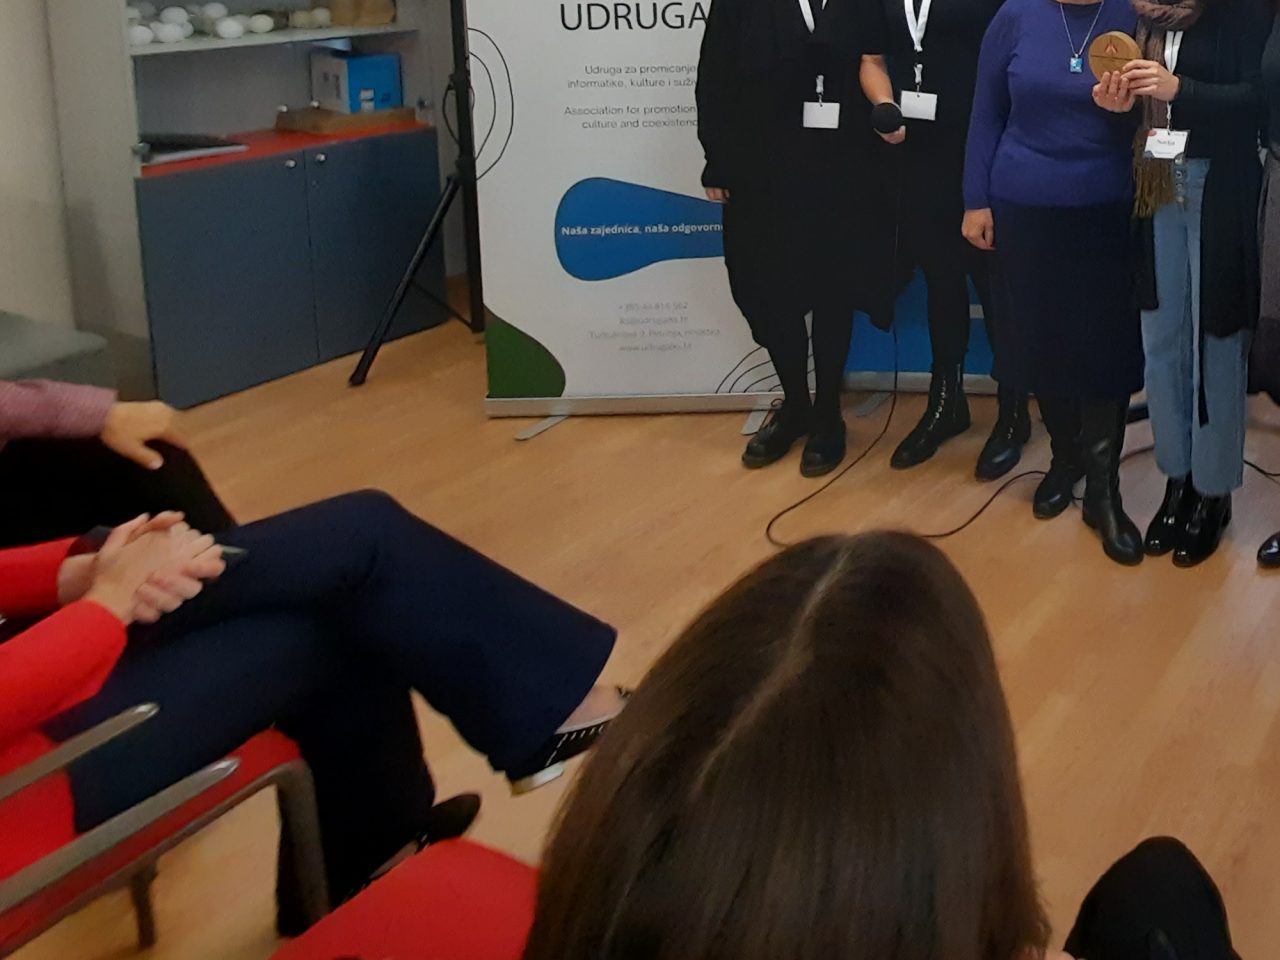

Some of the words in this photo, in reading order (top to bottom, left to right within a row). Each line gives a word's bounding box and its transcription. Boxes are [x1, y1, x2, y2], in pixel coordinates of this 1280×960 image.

[560, 2, 708, 31] UDRUGA
[585, 65, 622, 76] Udruga
[625, 66, 637, 75] za
[630, 77, 665, 88] kulture
[564, 106, 624, 116] Association
[626, 105, 640, 115] for
[643, 104, 696, 116] promotion
[582, 119, 617, 129] culture
[620, 119, 639, 129] and
[560, 225, 588, 236] Naša
[590, 223, 642, 237] zajednica,
[644, 222, 670, 234] naša
[671, 222, 723, 235] odgovorn
